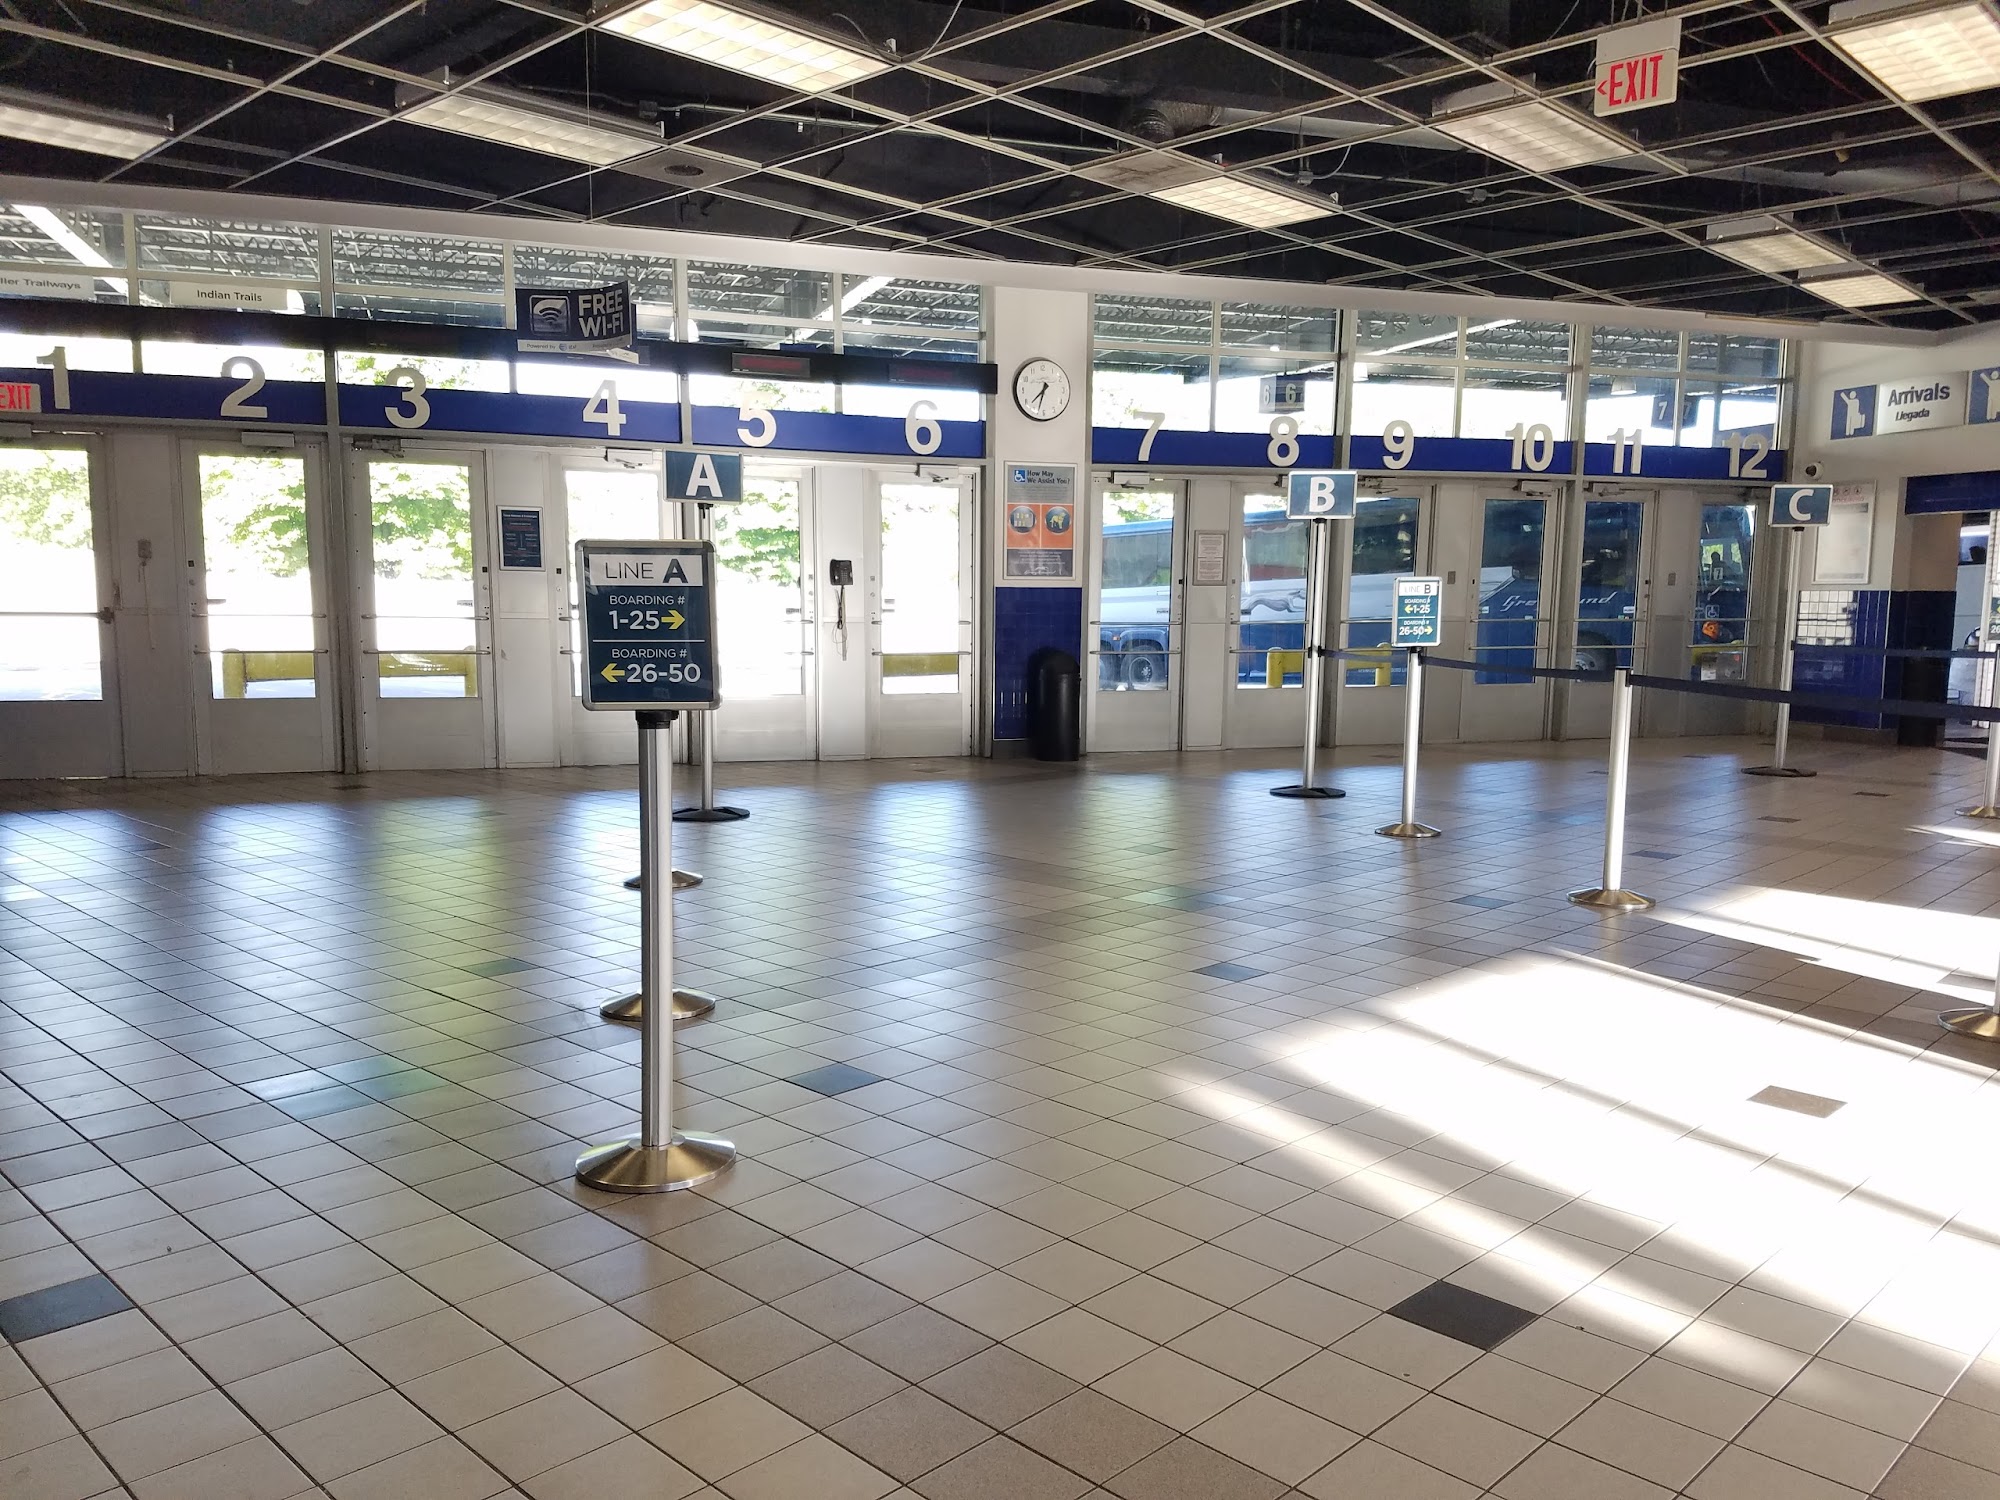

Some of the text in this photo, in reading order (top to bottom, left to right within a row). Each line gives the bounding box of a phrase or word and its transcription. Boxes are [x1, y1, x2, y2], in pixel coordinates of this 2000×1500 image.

[1608, 54, 1664, 107] EXIT
[22, 278, 82, 290] Trailways
[196, 289, 263, 302] Indian Trails
[578, 289, 623, 316] FREE
[578, 311, 624, 338] WI-FI
[36, 346, 71, 409] 1
[220, 355, 268, 419] 2
[384, 367, 431, 429] 3
[1263, 384, 1270, 405] 6
[1285, 383, 1297, 404] 6
[1887, 382, 1951, 408] Arrivals
[583, 379, 627, 436] 4
[737, 391, 777, 447] 5
[1658, 401, 1668, 420] 7
[1895, 408, 1930, 422] Llegada
[905, 399, 942, 455] 6
[1133, 411, 1166, 462] 7
[1267, 416, 1300, 467] 8
[1382, 420, 1415, 470] 9
[1505, 422, 1554, 472] 10
[1607, 428, 1643, 474] 11
[1723, 432, 1768, 479] 12
[685, 454, 724, 498] A
[1308, 476, 1335, 513] B
[1788, 488, 1815, 521] C
[604, 558, 689, 584] LINE A
[609, 595, 686, 605] BOARDING #
[1424, 584, 1431, 594] B
[608, 610, 660, 630] 1-25
[1413, 604, 1431, 614] 1-25
[1398, 626, 1425, 636] 26-50
[611, 648, 688, 659] BOARDING #
[626, 663, 702, 683] 26-50
